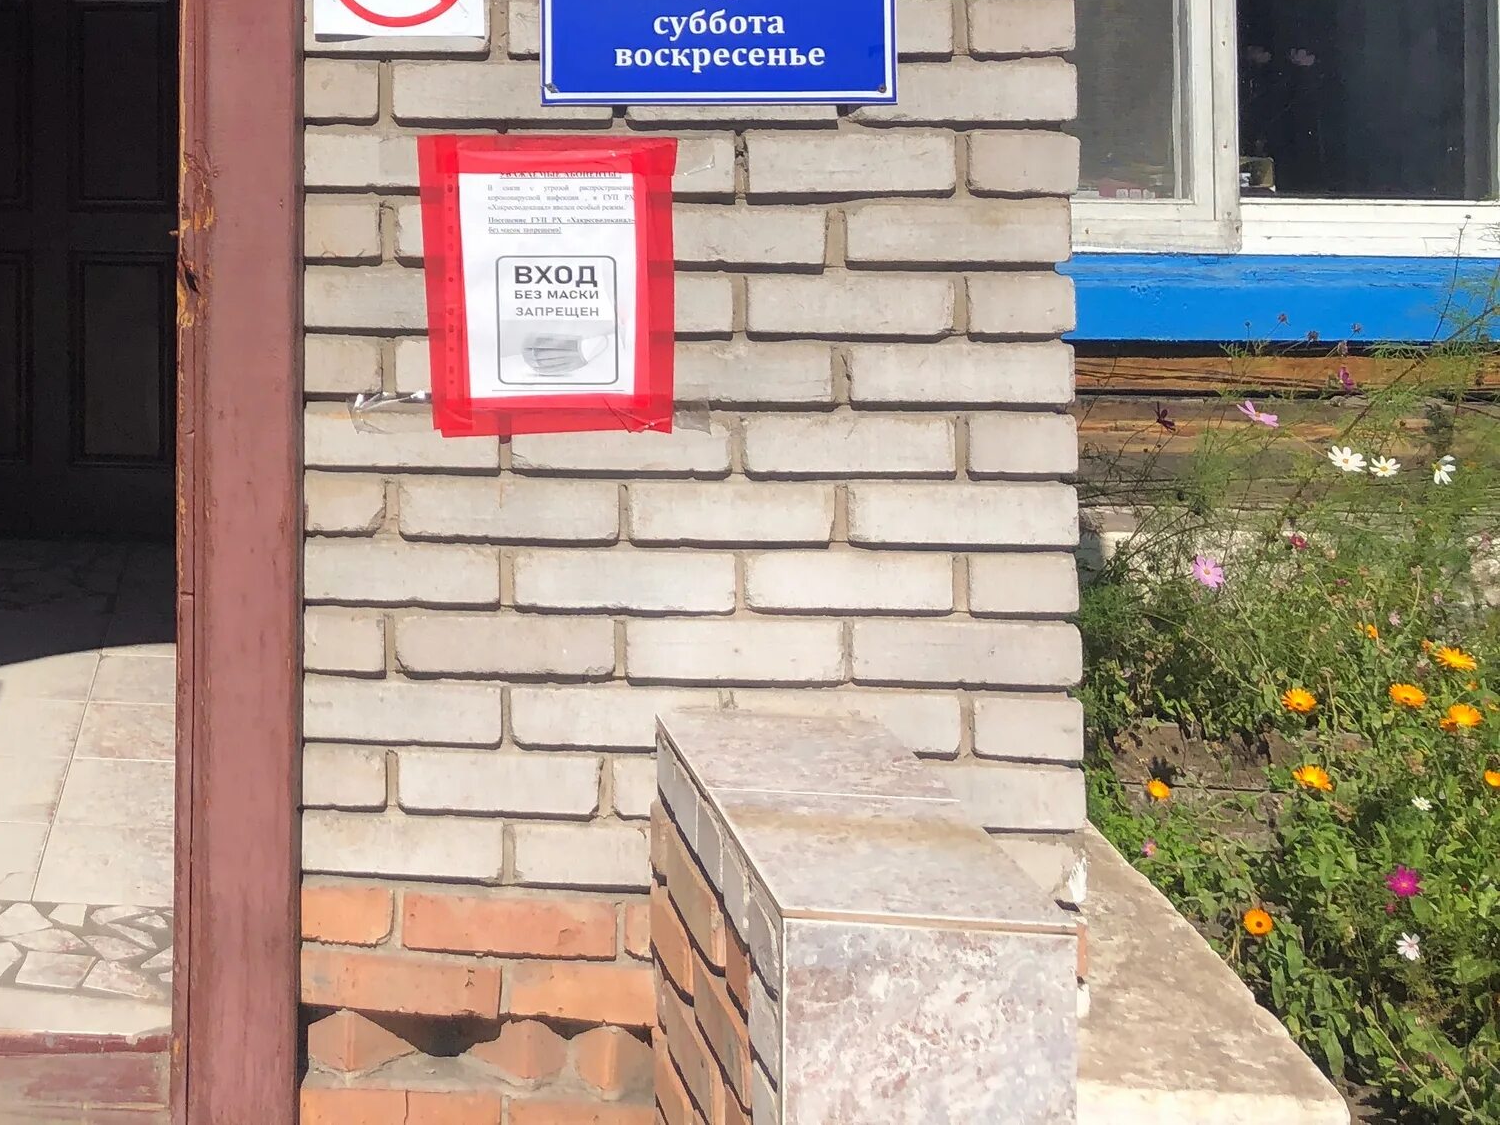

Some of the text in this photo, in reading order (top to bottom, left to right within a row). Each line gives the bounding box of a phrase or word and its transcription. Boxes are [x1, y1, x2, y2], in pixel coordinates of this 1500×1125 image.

[653, 8, 785, 41] суббота
[613, 46, 826, 73] воскресенье
[514, 265, 598, 288] ВХОД
[514, 290, 599, 299] БЕЗ МАСКИ
[515, 307, 599, 318] ЗАПРЕЩЕН
